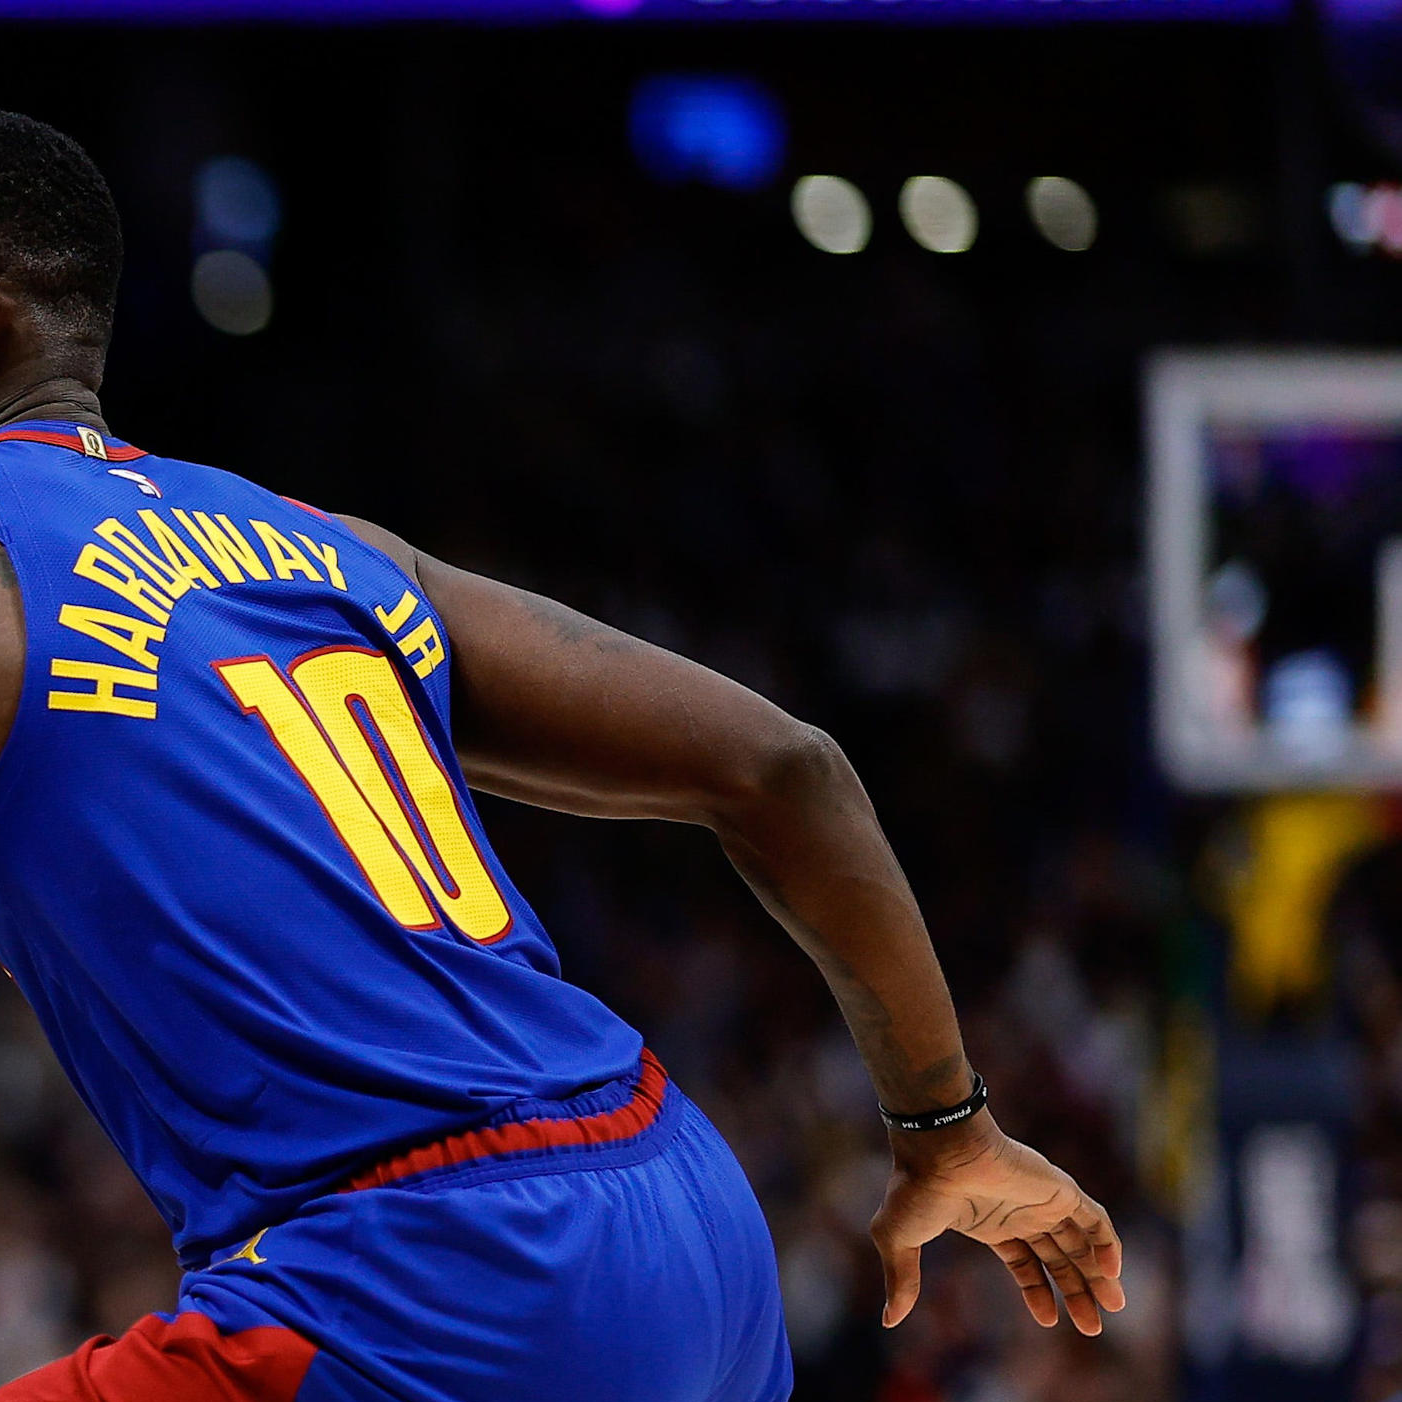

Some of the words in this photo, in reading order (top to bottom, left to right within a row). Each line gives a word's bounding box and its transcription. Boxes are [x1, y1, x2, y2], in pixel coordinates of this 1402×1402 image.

[47, 507, 349, 720] HARDAWAY
[374, 590, 446, 680] JR
[210, 645, 513, 945] 10
[934, 1105, 972, 1127] FAMILY
